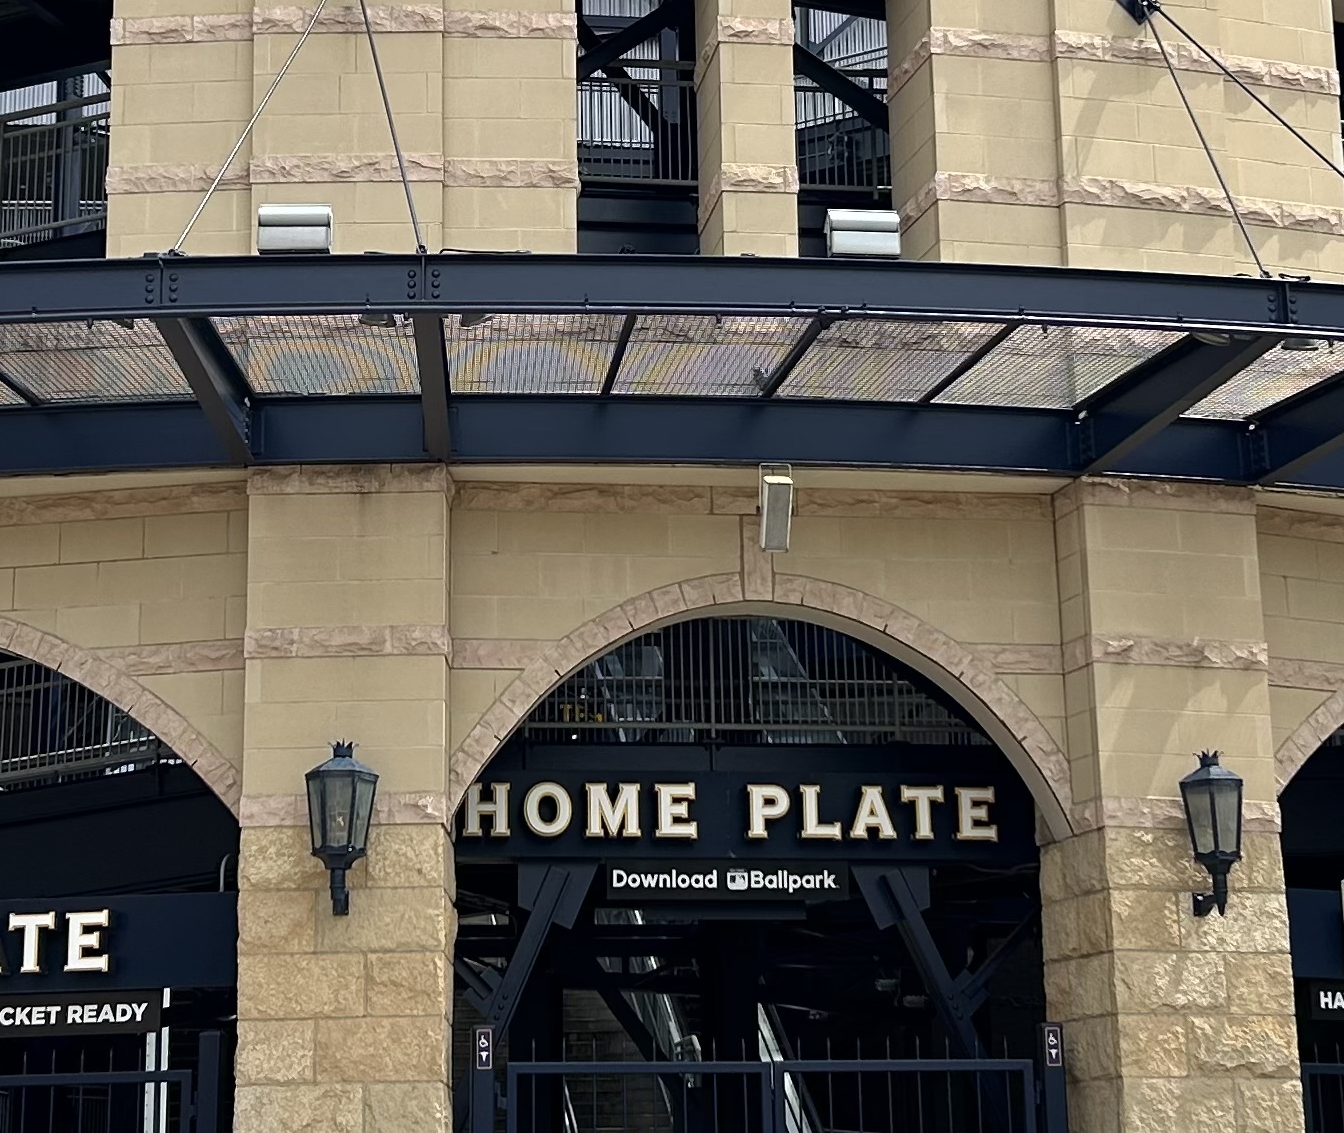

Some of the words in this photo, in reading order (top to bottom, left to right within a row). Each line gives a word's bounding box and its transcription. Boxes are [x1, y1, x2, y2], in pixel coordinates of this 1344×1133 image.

[462, 781, 699, 840] HOME
[746, 783, 999, 842] PLATE
[612, 869, 718, 888] Download
[750, 869, 836, 893] Ballpark
[66, 1002, 148, 1025] READY
